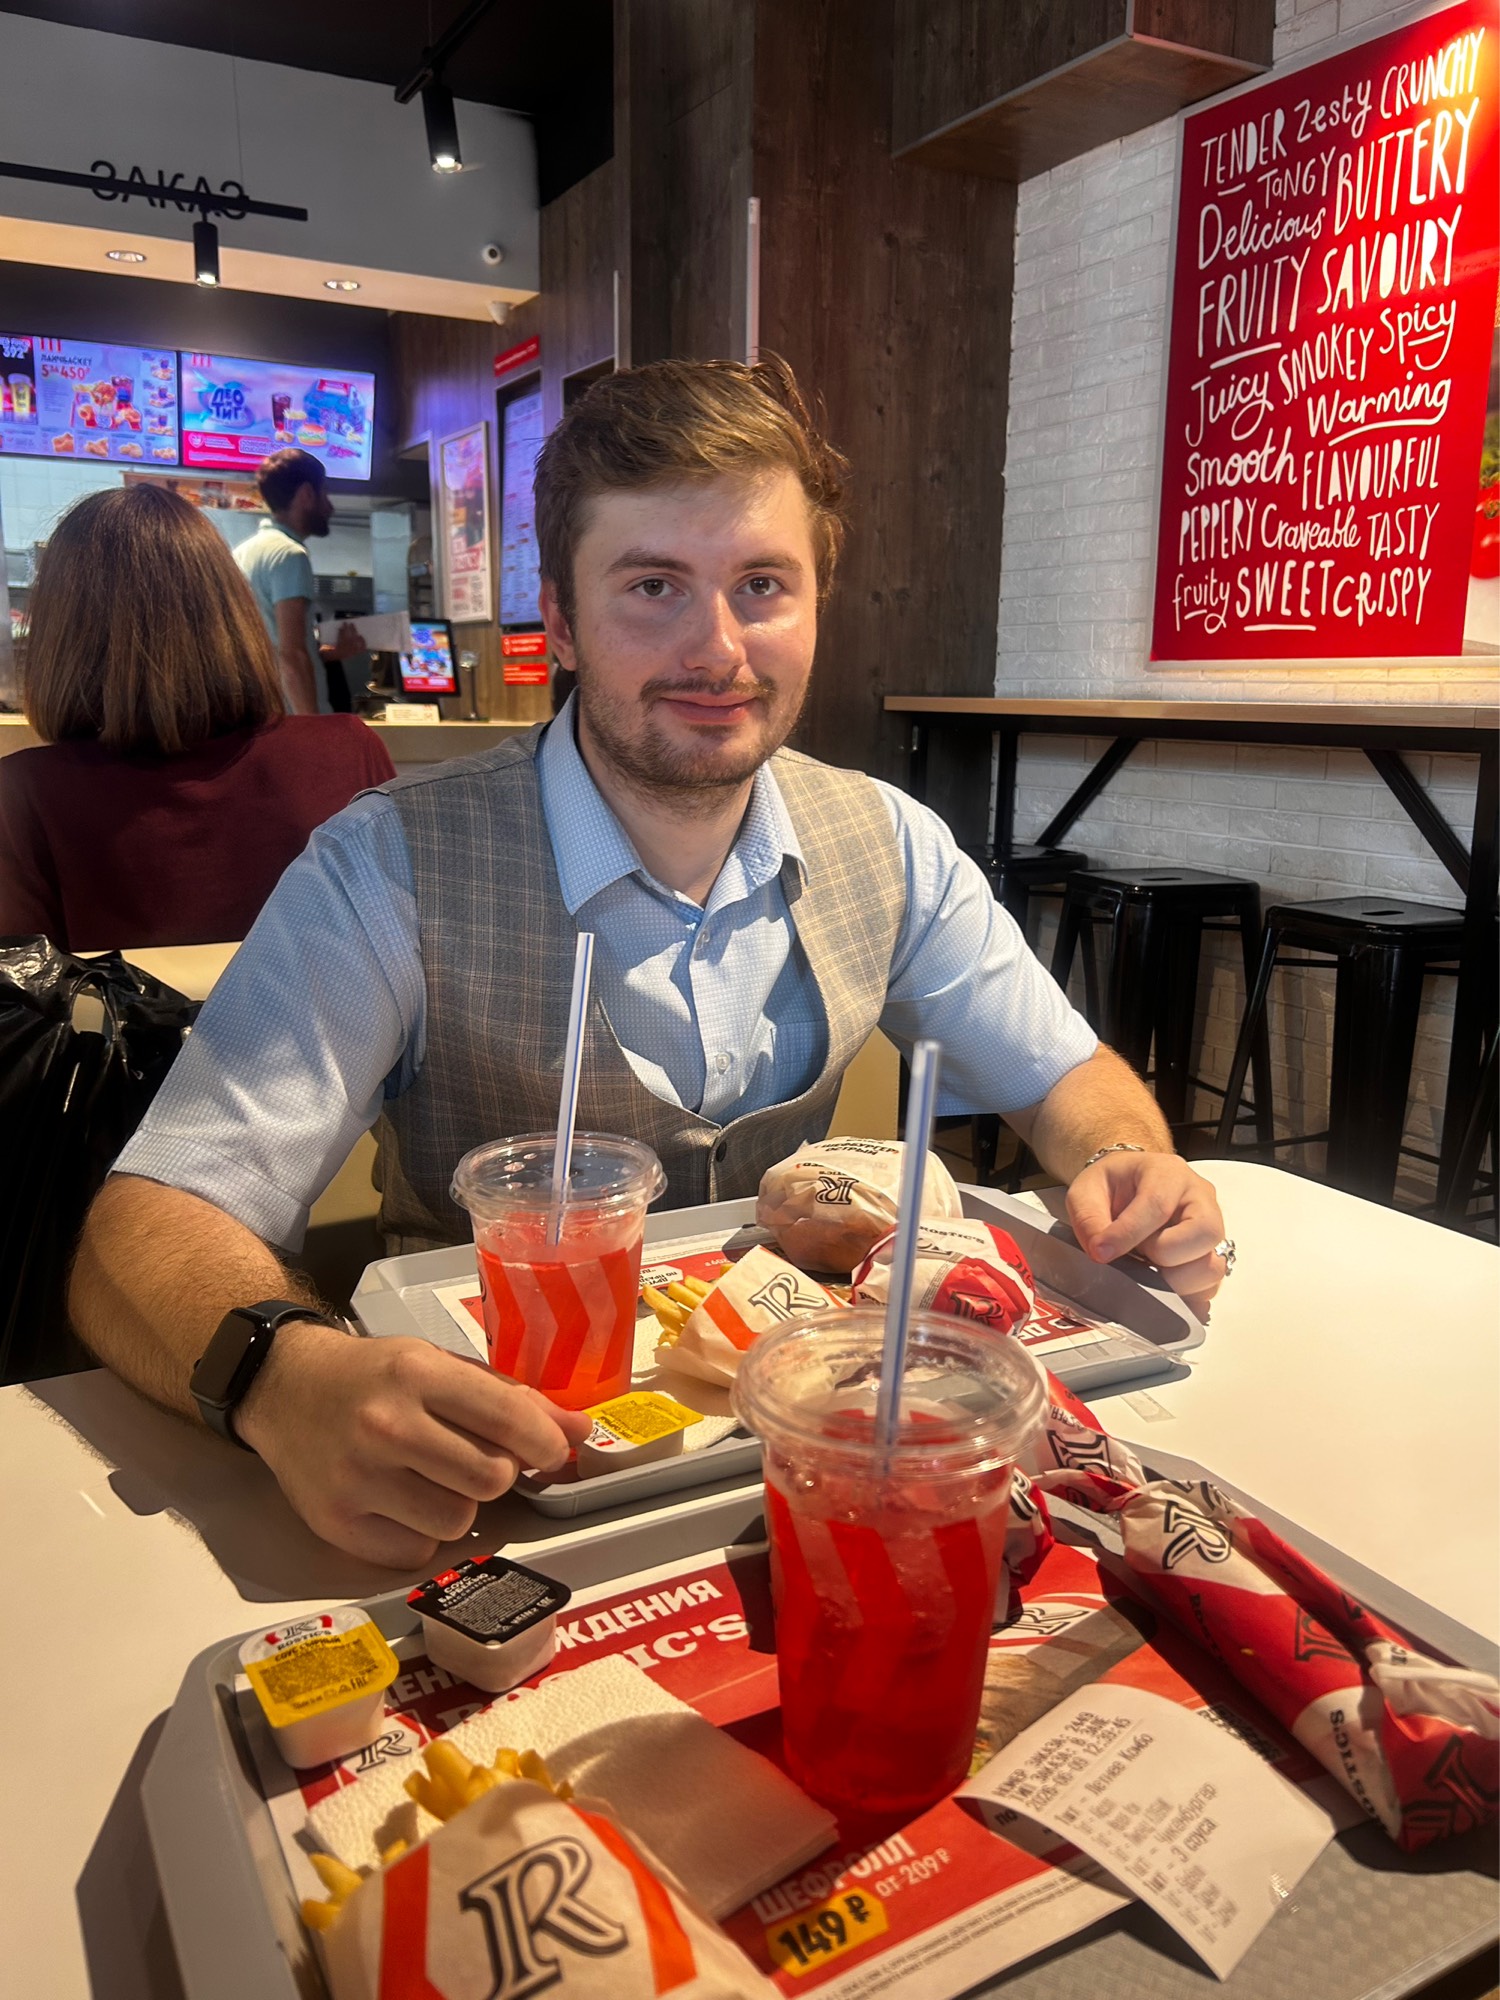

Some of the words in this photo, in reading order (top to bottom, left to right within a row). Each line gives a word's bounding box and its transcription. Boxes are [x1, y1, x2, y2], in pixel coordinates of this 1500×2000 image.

[1201, 108, 1287, 187] TENDER
[1294, 80, 1372, 139] Zesty
[1380, 27, 1485, 120] CRUNCHY
[1334, 96, 1479, 236] BUTTERY
[1198, 199, 1327, 270] Delicious
[1198, 246, 1311, 358] FRUITY
[1316, 204, 1462, 314] SAVOURY
[212, 388, 245, 406] ЛЕО
[1185, 371, 1274, 447] Juicy
[1278, 322, 1375, 405] SMOKEY
[1379, 300, 1457, 370] Spicy
[1307, 371, 1452, 446] Warming
[1185, 426, 1297, 497] Smooth
[1301, 434, 1441, 511] FLAVOURFUL
[1179, 496, 1257, 566] PEPPERY
[1261, 503, 1362, 553] Craveable
[1367, 502, 1440, 561] TASTY
[1172, 567, 1231, 634] fruity
[1235, 559, 1335, 618] SWEET
[1332, 566, 1432, 627] CRISPY
[555, 1579, 723, 1653] ЖДЕНИЯ
[778, 1910, 848, 1966] 149
